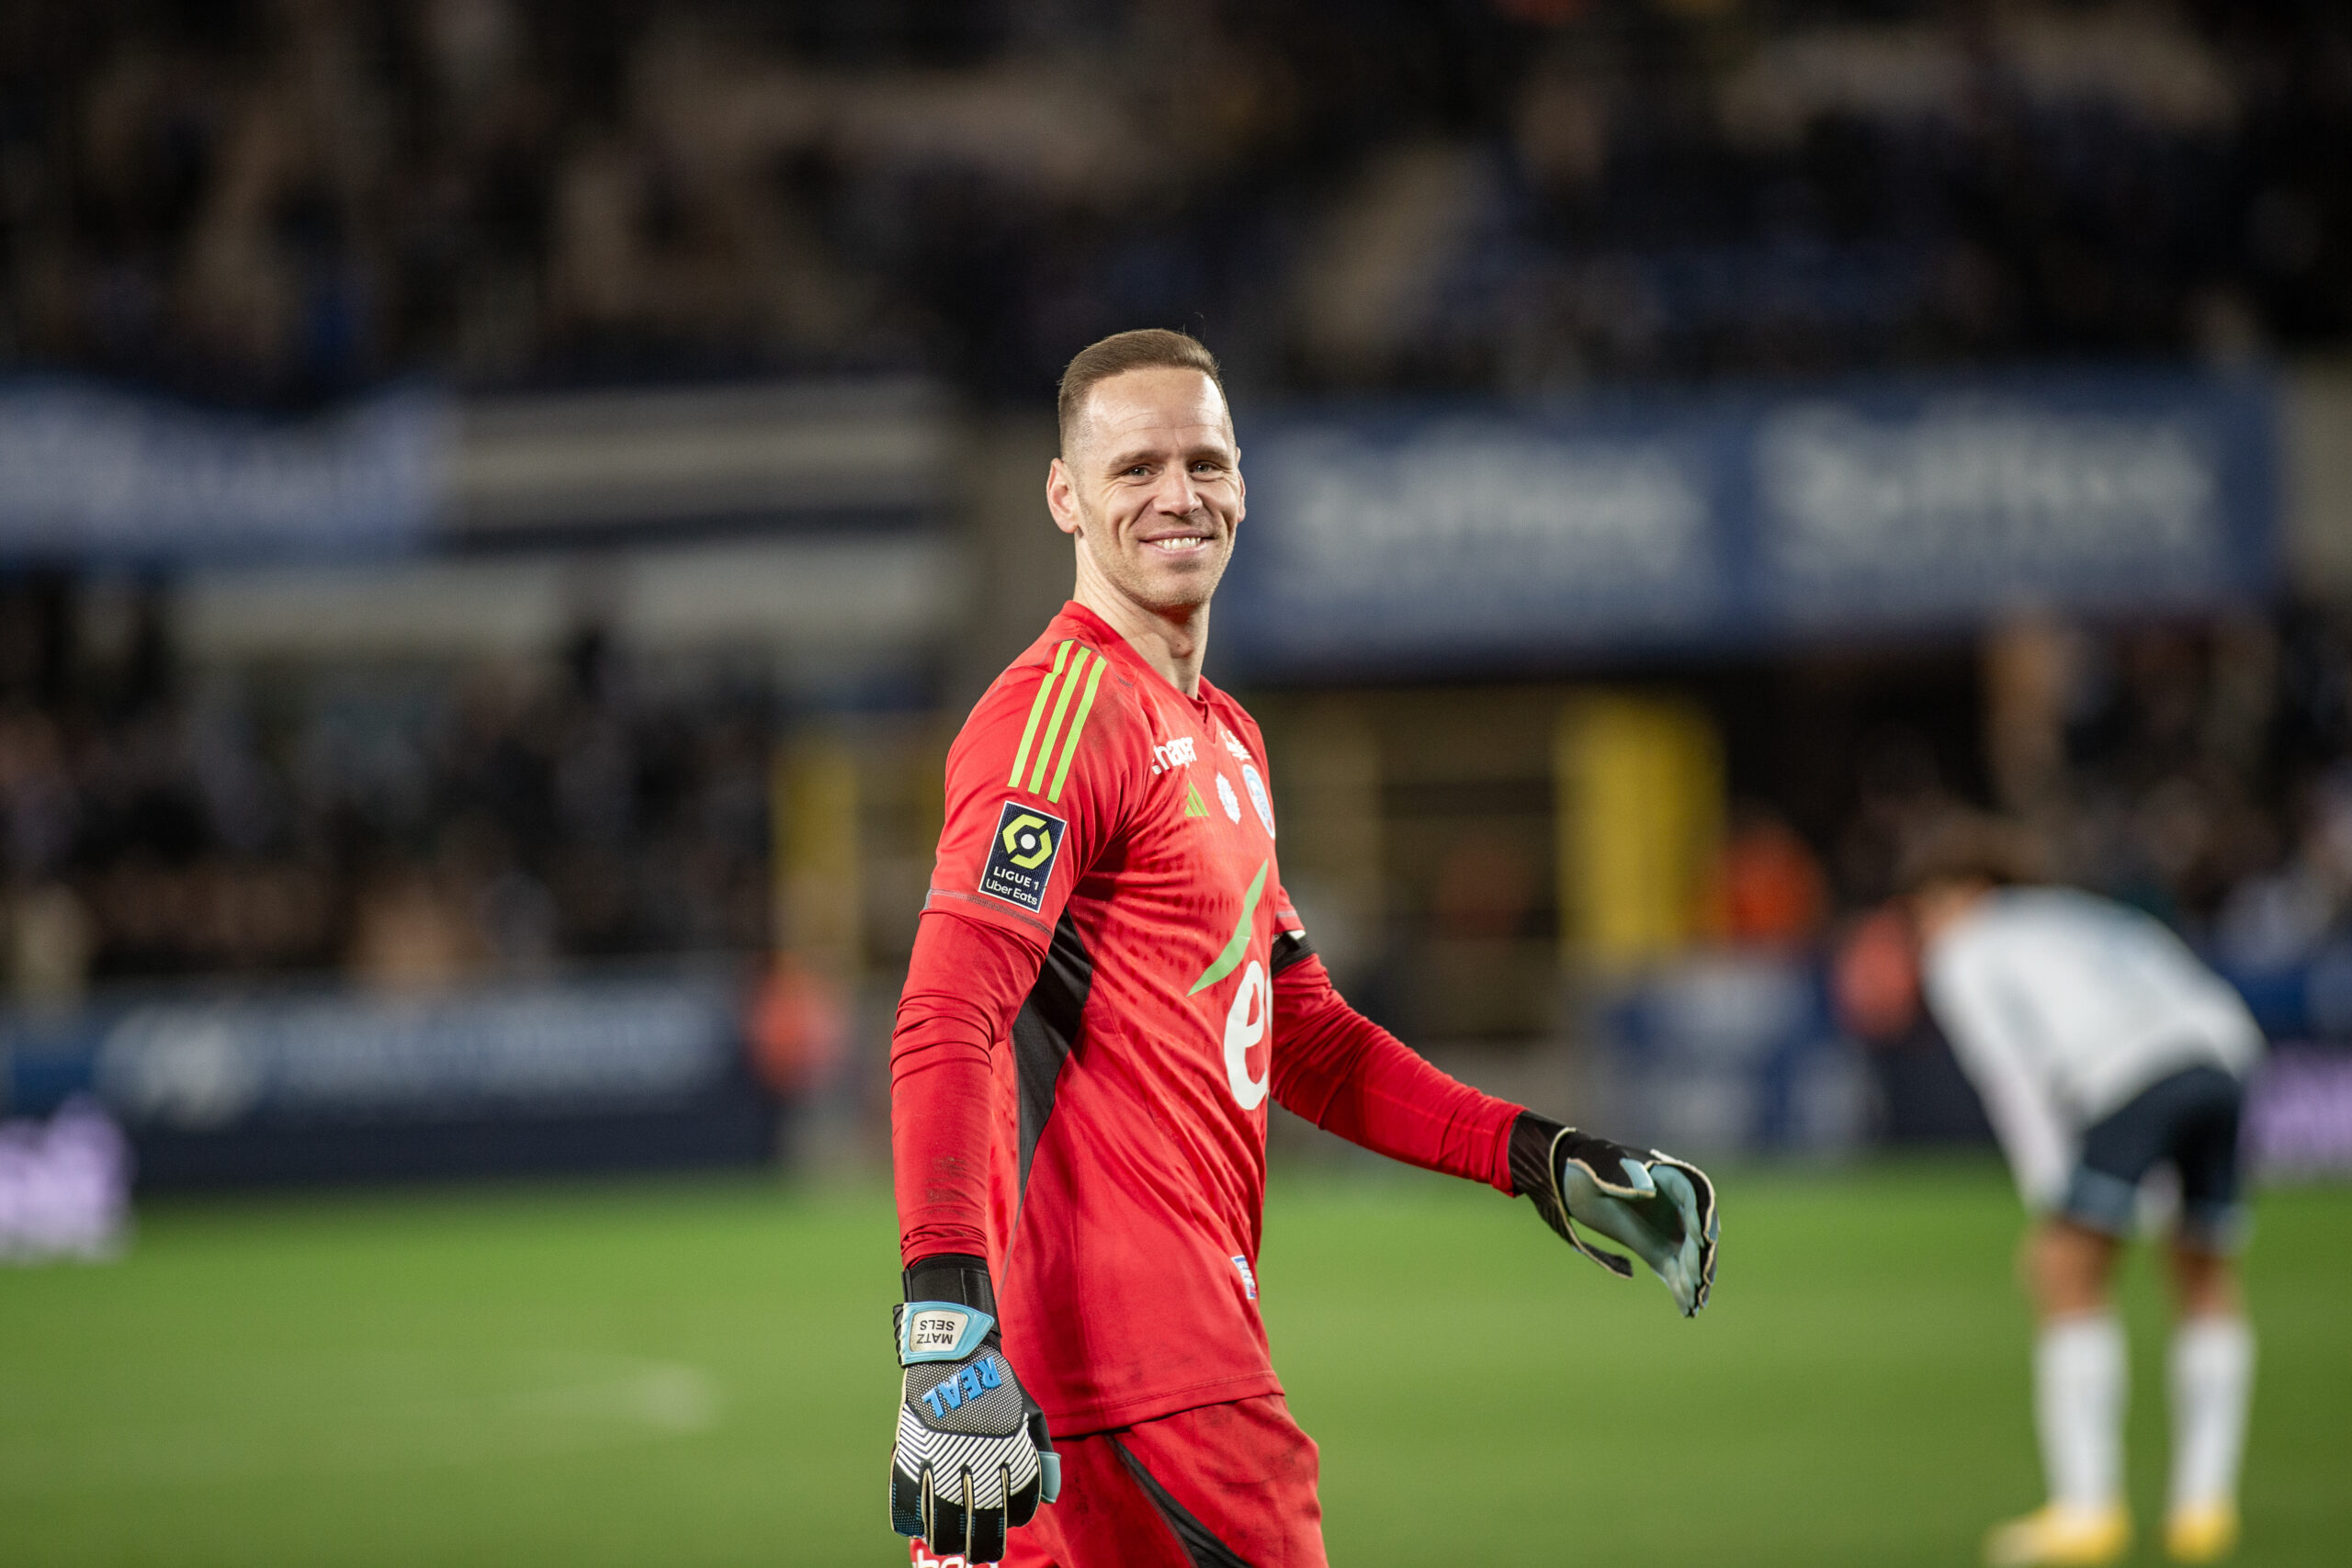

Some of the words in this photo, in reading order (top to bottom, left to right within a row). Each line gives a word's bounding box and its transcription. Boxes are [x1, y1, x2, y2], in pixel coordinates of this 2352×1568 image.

[993, 866, 1032, 887] LIGUE
[1034, 882, 1039, 891] 1
[986, 878, 1012, 895] Uber
[1013, 888, 1037, 906] Eats
[920, 1319, 955, 1331] SELS
[916, 1333, 953, 1344] MATZ
[922, 1356, 1002, 1418] REAL
